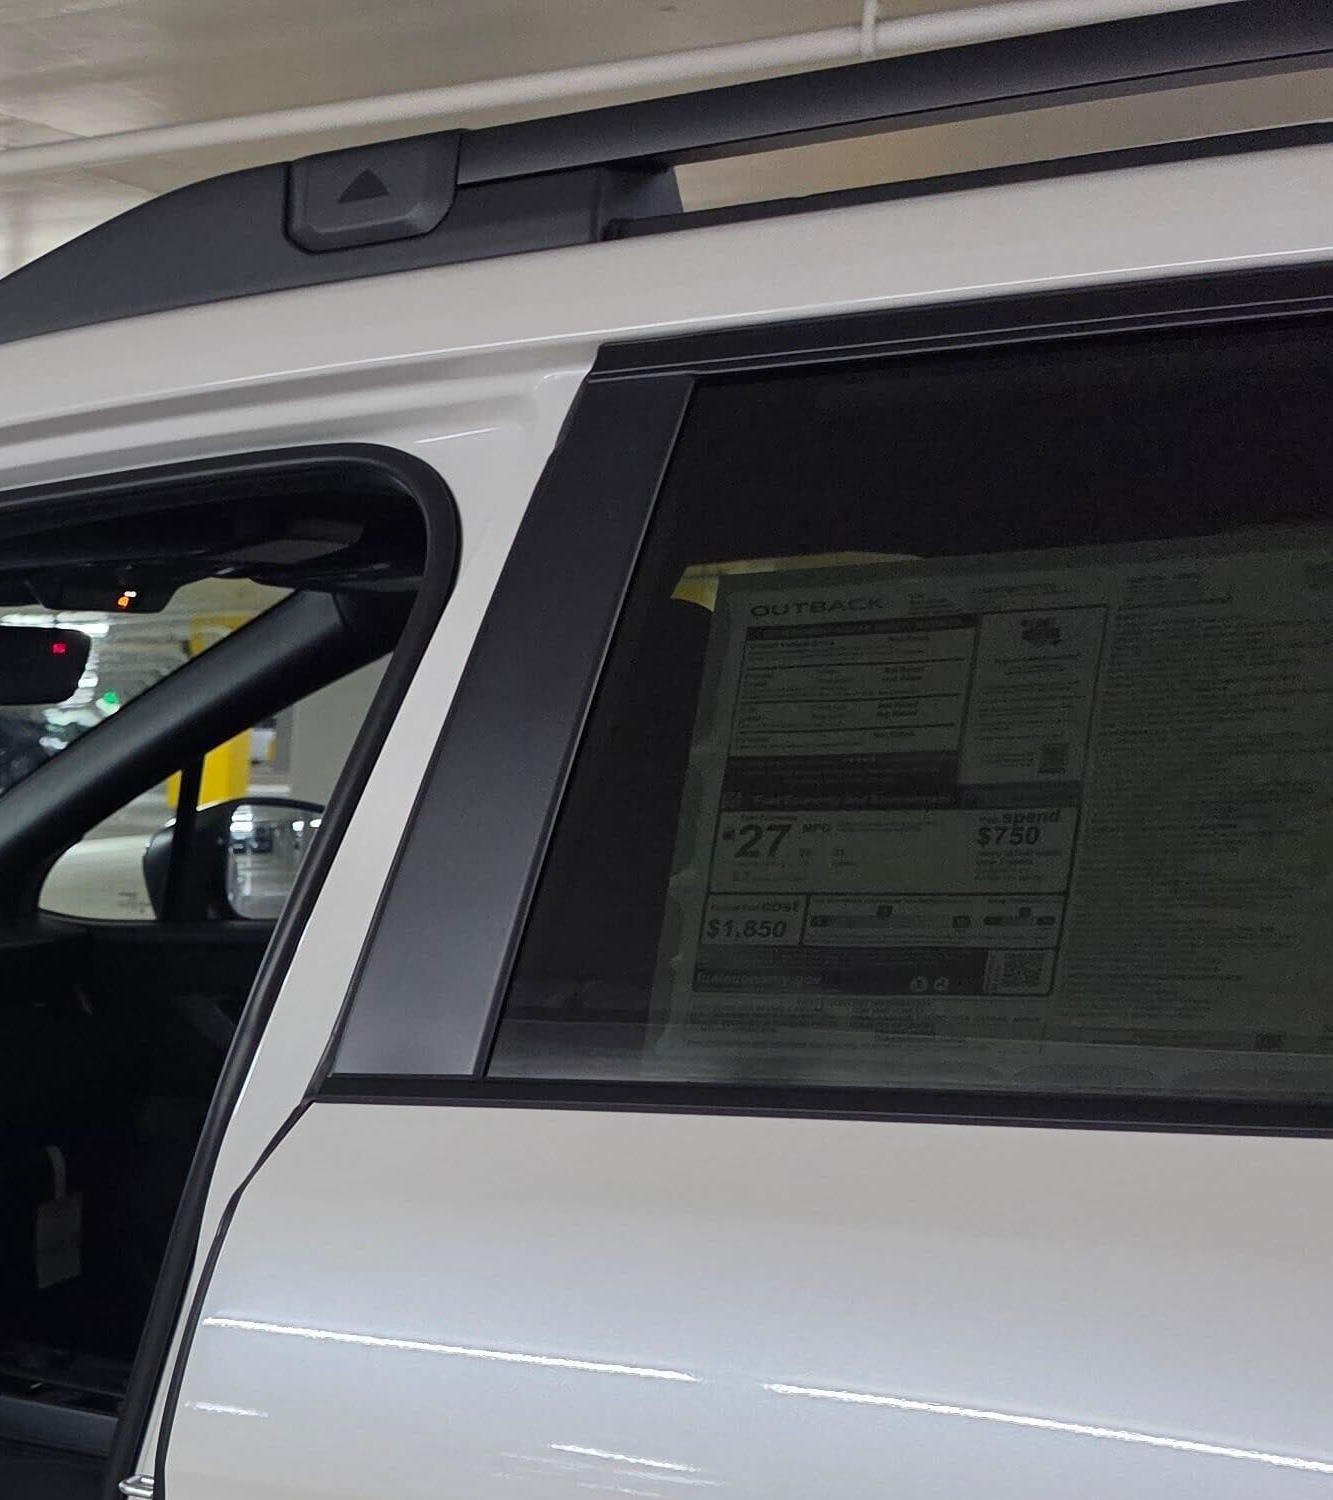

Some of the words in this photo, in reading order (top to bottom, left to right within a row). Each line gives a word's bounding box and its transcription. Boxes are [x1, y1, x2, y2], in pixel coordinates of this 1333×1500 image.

[749, 597, 885, 618] OUTBACK
[733, 823, 794, 859] 27
[976, 825, 1041, 848] $750
[706, 918, 787, 939] $1,850
